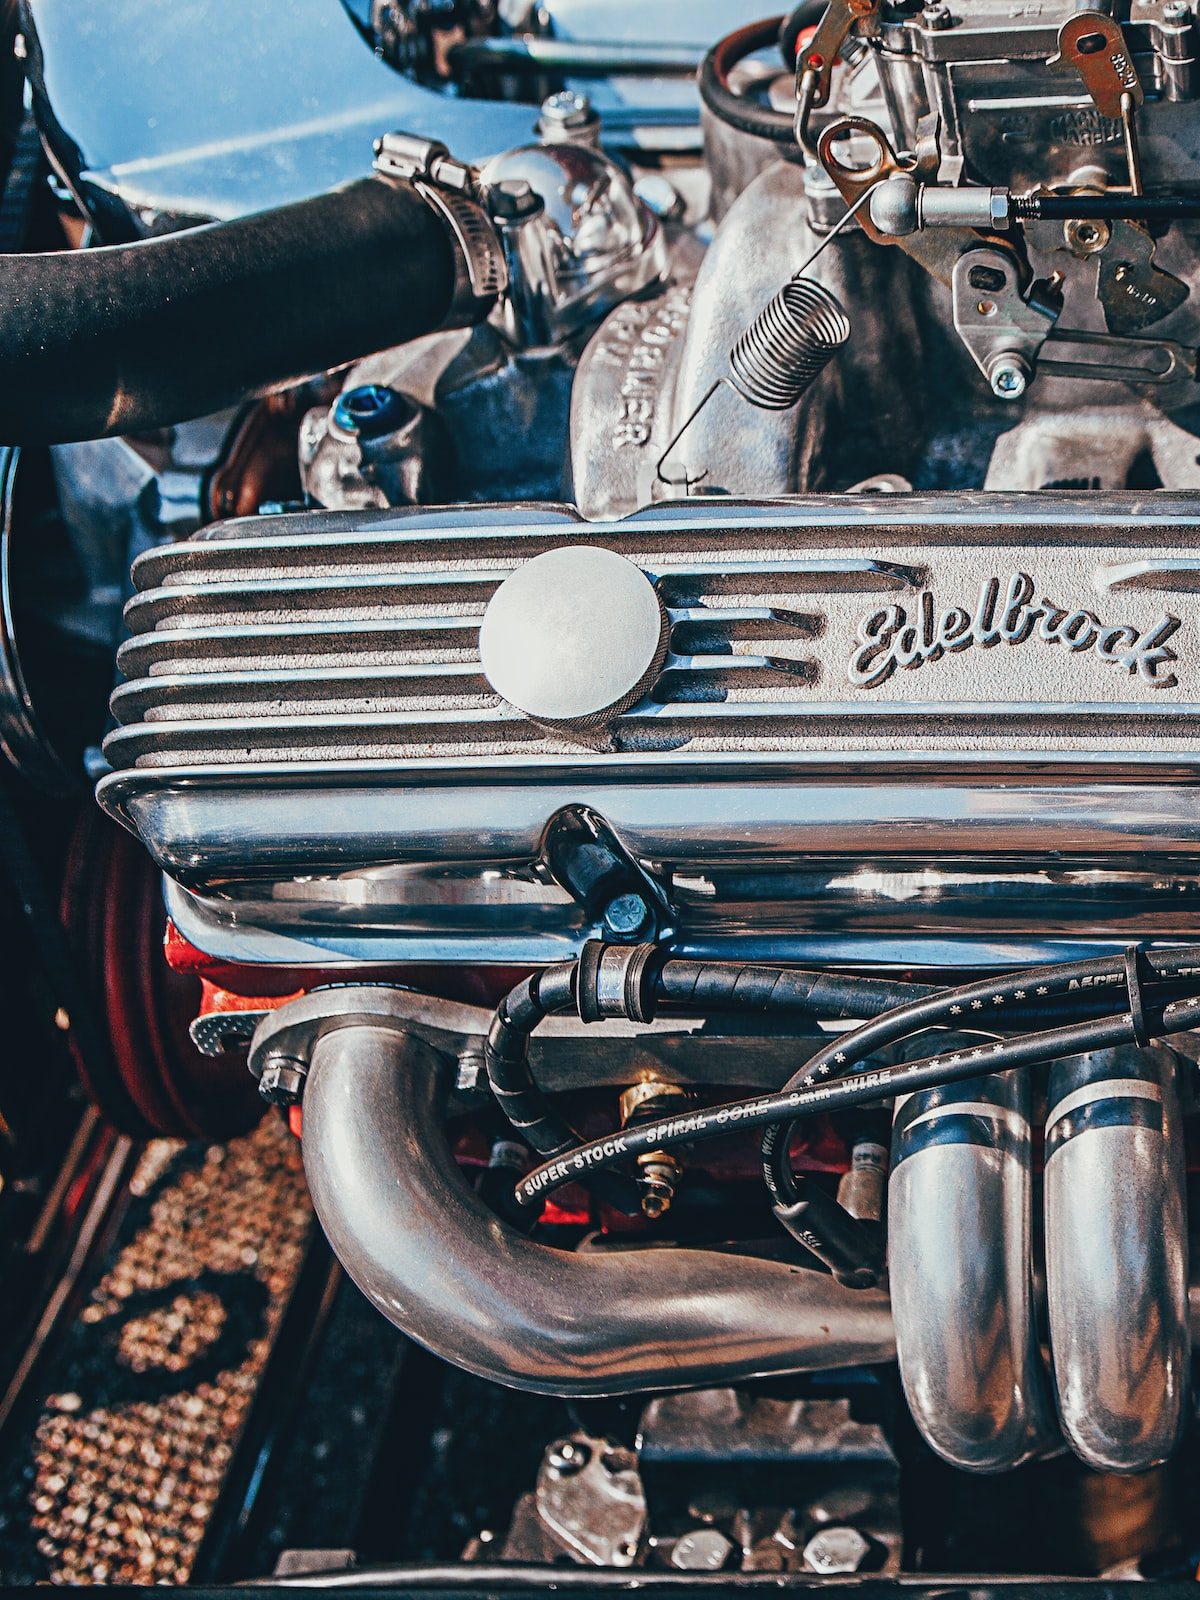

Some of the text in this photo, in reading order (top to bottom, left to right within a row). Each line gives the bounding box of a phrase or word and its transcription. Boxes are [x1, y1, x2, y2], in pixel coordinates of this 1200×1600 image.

[847, 571, 1182, 690] Edelbrock
[524, 1163, 571, 1199] SUPER
[573, 1135, 628, 1171] STOCK
[645, 1113, 709, 1146] SPIRAL
[716, 1098, 772, 1126] CORE
[788, 1084, 832, 1110] 8mm
[841, 1067, 893, 1096] WIRE
